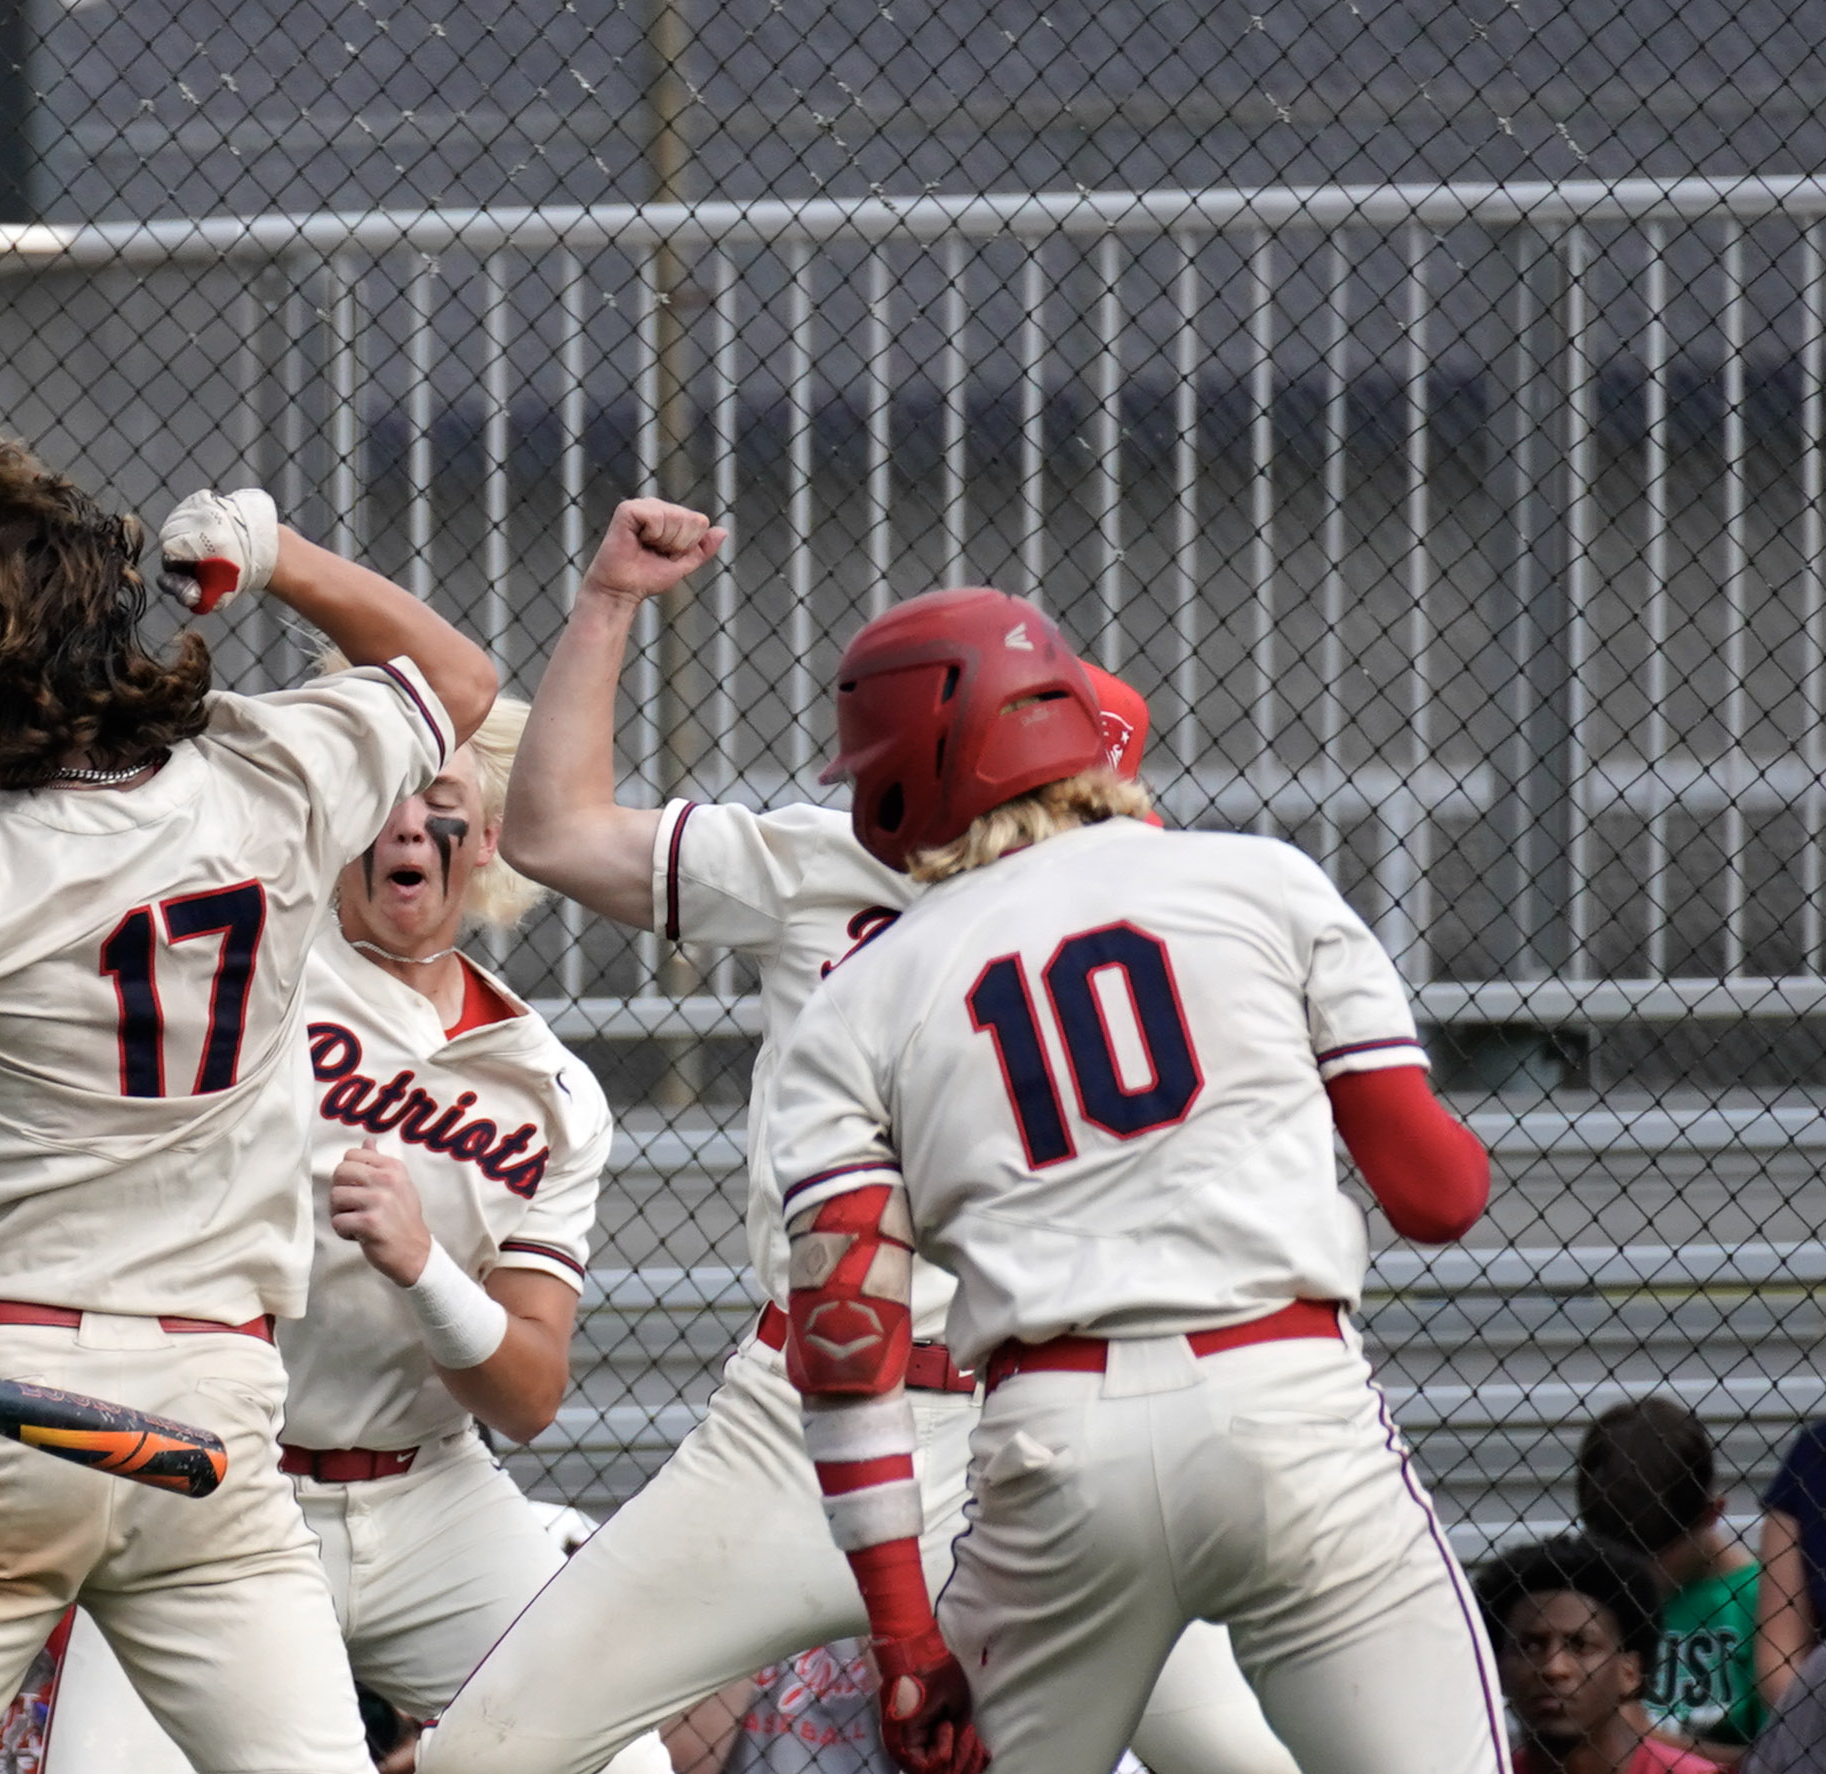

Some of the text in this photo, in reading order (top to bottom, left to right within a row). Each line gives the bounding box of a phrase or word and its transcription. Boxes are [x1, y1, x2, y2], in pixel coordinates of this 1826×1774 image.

[99, 878, 268, 1098] 17
[964, 918, 1206, 1172] 10
[307, 1021, 550, 1200] Patriots
